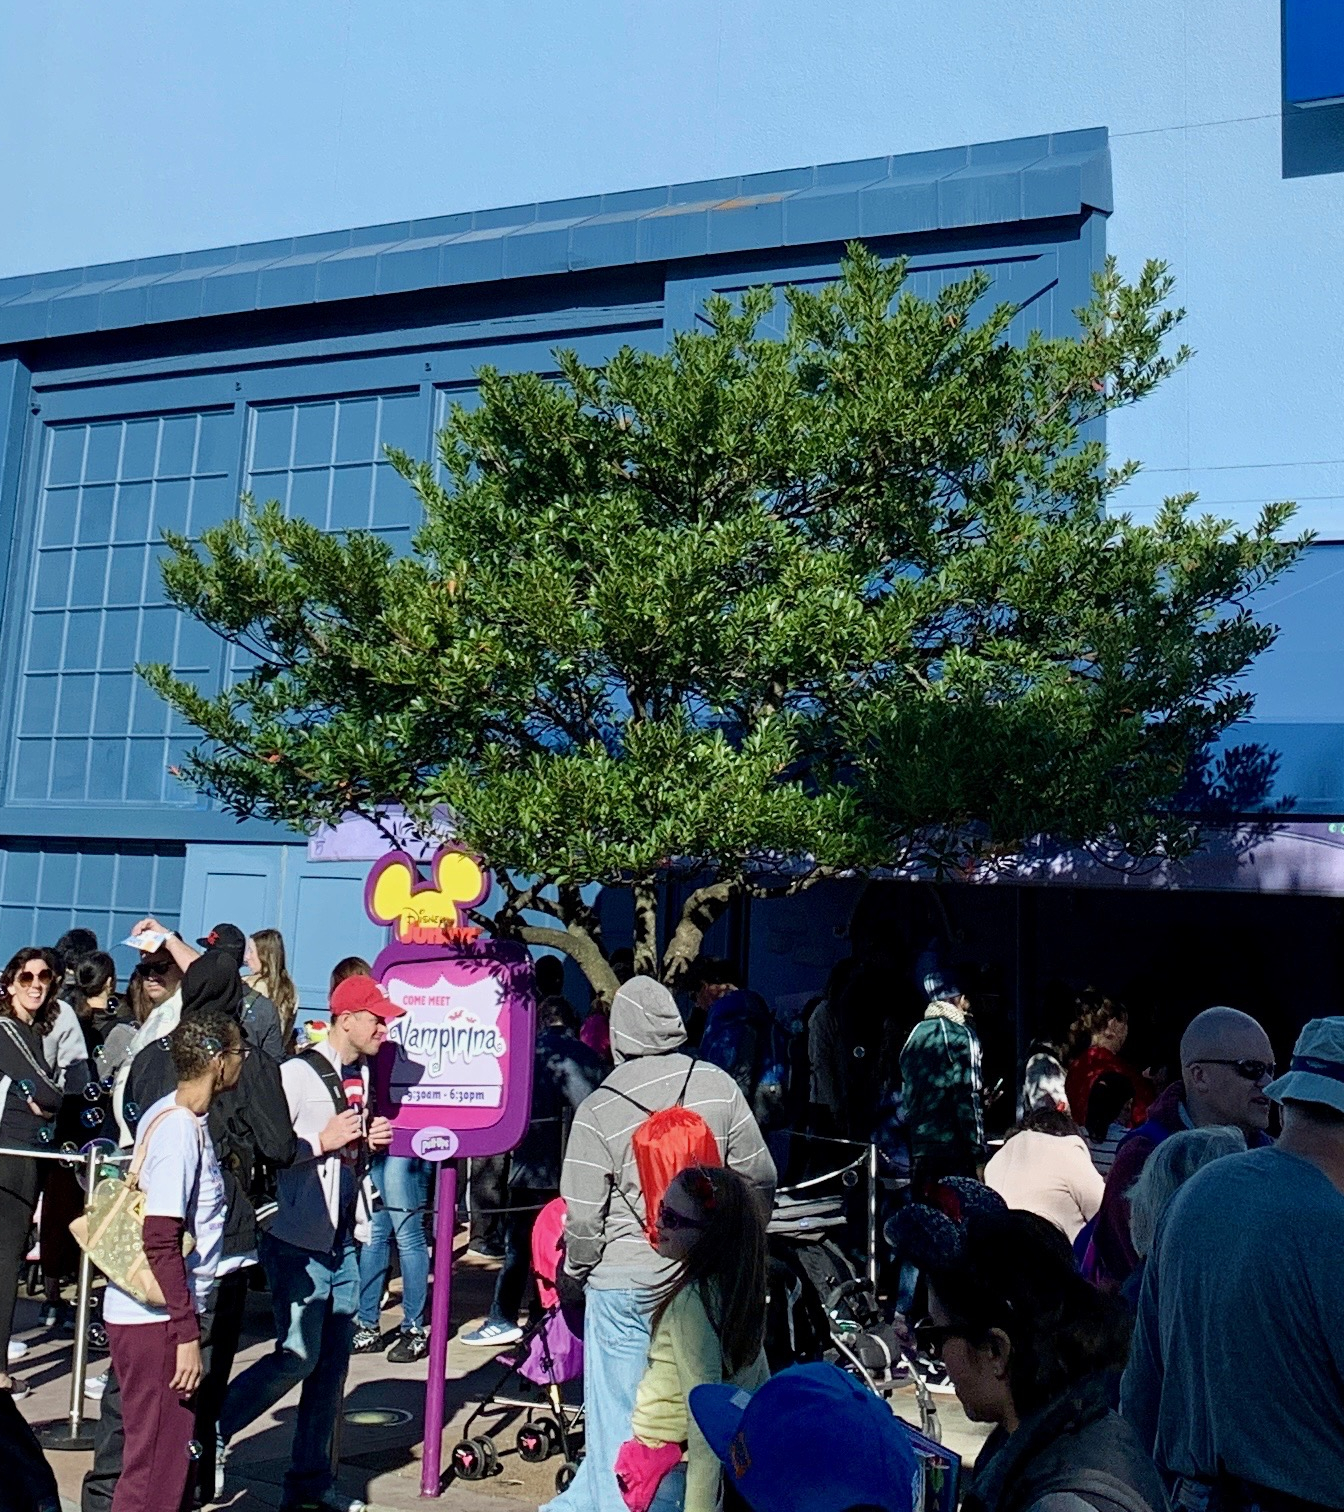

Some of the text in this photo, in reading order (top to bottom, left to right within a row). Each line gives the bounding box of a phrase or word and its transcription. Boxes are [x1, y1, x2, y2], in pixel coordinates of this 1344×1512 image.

[403, 995, 451, 1006] COME MEET
[390, 1016, 502, 1073] Vampirina
[449, 1089, 485, 1102] 6:30pm
